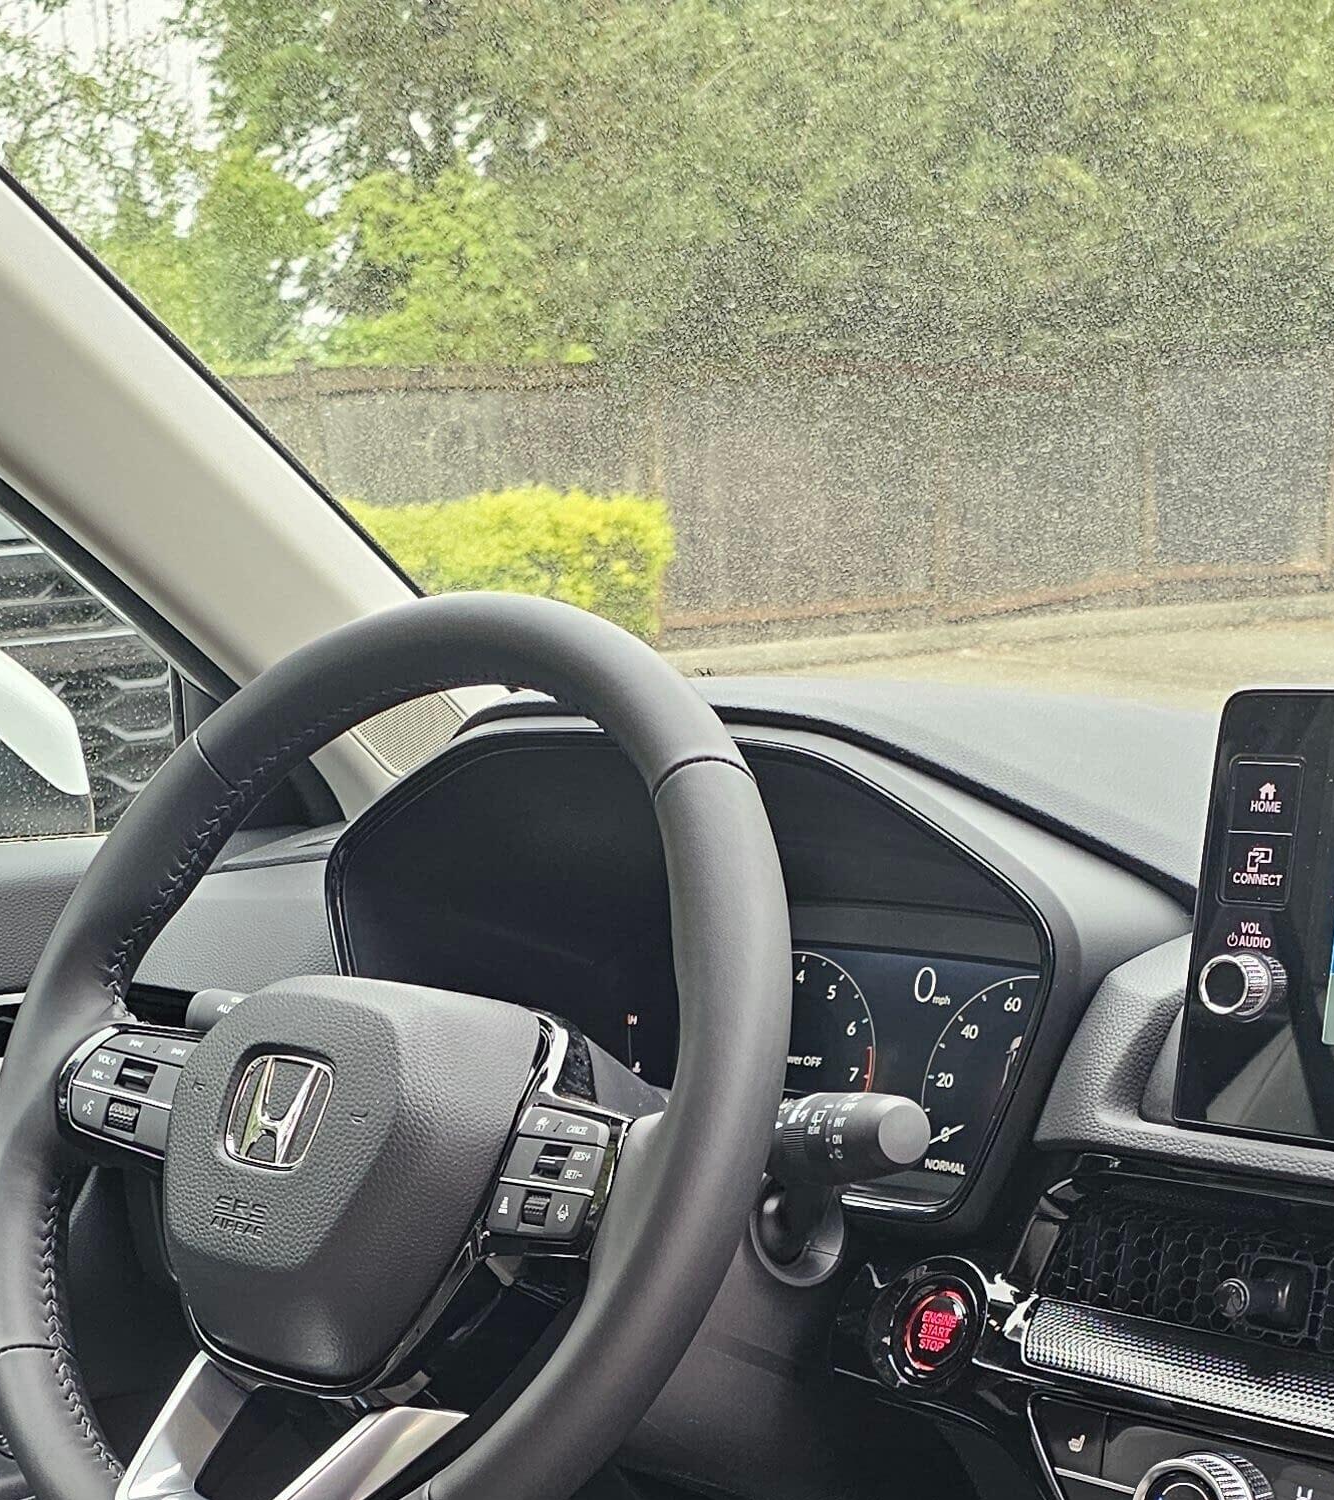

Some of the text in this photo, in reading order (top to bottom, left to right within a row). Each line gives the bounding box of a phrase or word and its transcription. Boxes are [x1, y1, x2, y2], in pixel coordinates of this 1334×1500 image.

[1250, 800, 1282, 813] HOME
[1232, 872, 1283, 887] CONNECT
[1240, 922, 1261, 935] VOL
[1238, 937, 1271, 949] AUDIO
[795, 969, 806, 984] 4
[826, 985, 837, 1000] 5
[914, 966, 951, 1007] 0 mph
[1003, 996, 1022, 1013] 60
[846, 1020, 857, 1036] 6
[960, 1023, 979, 1040] 40
[787, 1056, 822, 1067] wer OFF
[849, 1067, 859, 1083] 7
[936, 1072, 954, 1088] 20
[924, 1157, 966, 1176] NORMAL
[213, 1195, 269, 1219] SRS
[921, 1310, 957, 1329] ENGINE
[920, 1323, 952, 1338] START
[918, 1338, 945, 1352] STOP
